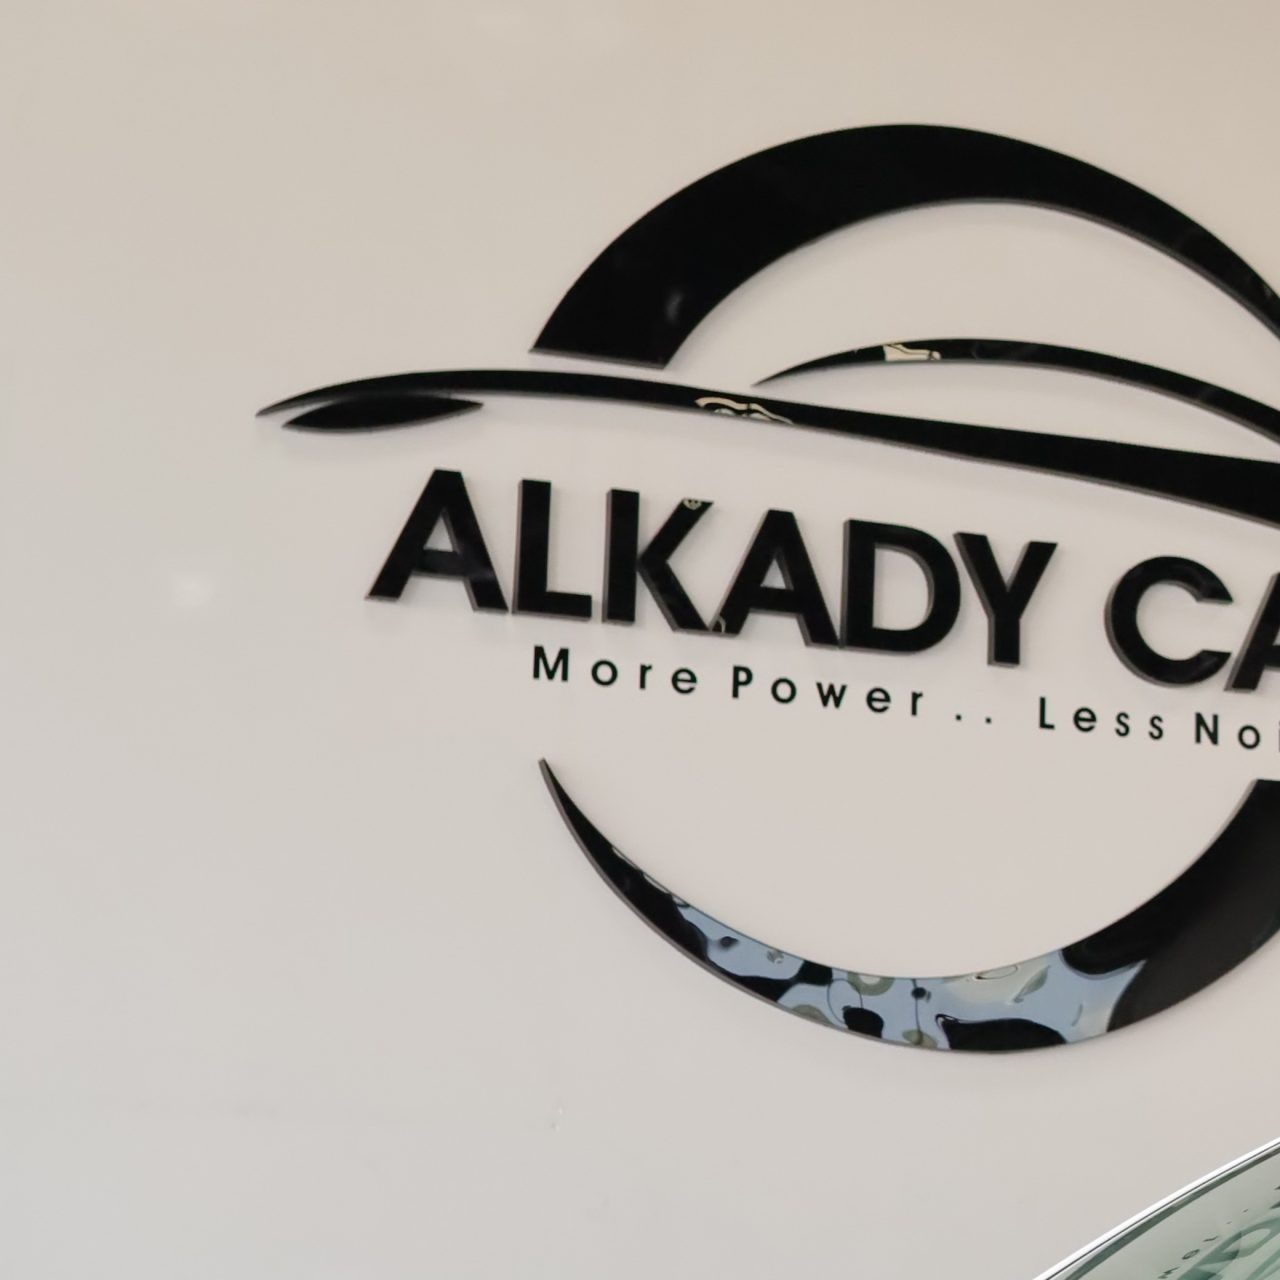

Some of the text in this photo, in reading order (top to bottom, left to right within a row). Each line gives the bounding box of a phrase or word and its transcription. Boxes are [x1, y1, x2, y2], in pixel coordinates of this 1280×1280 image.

[364, 468, 1059, 669] ALKADY
[532, 645, 698, 695] More
[1039, 696, 1164, 741] Less
